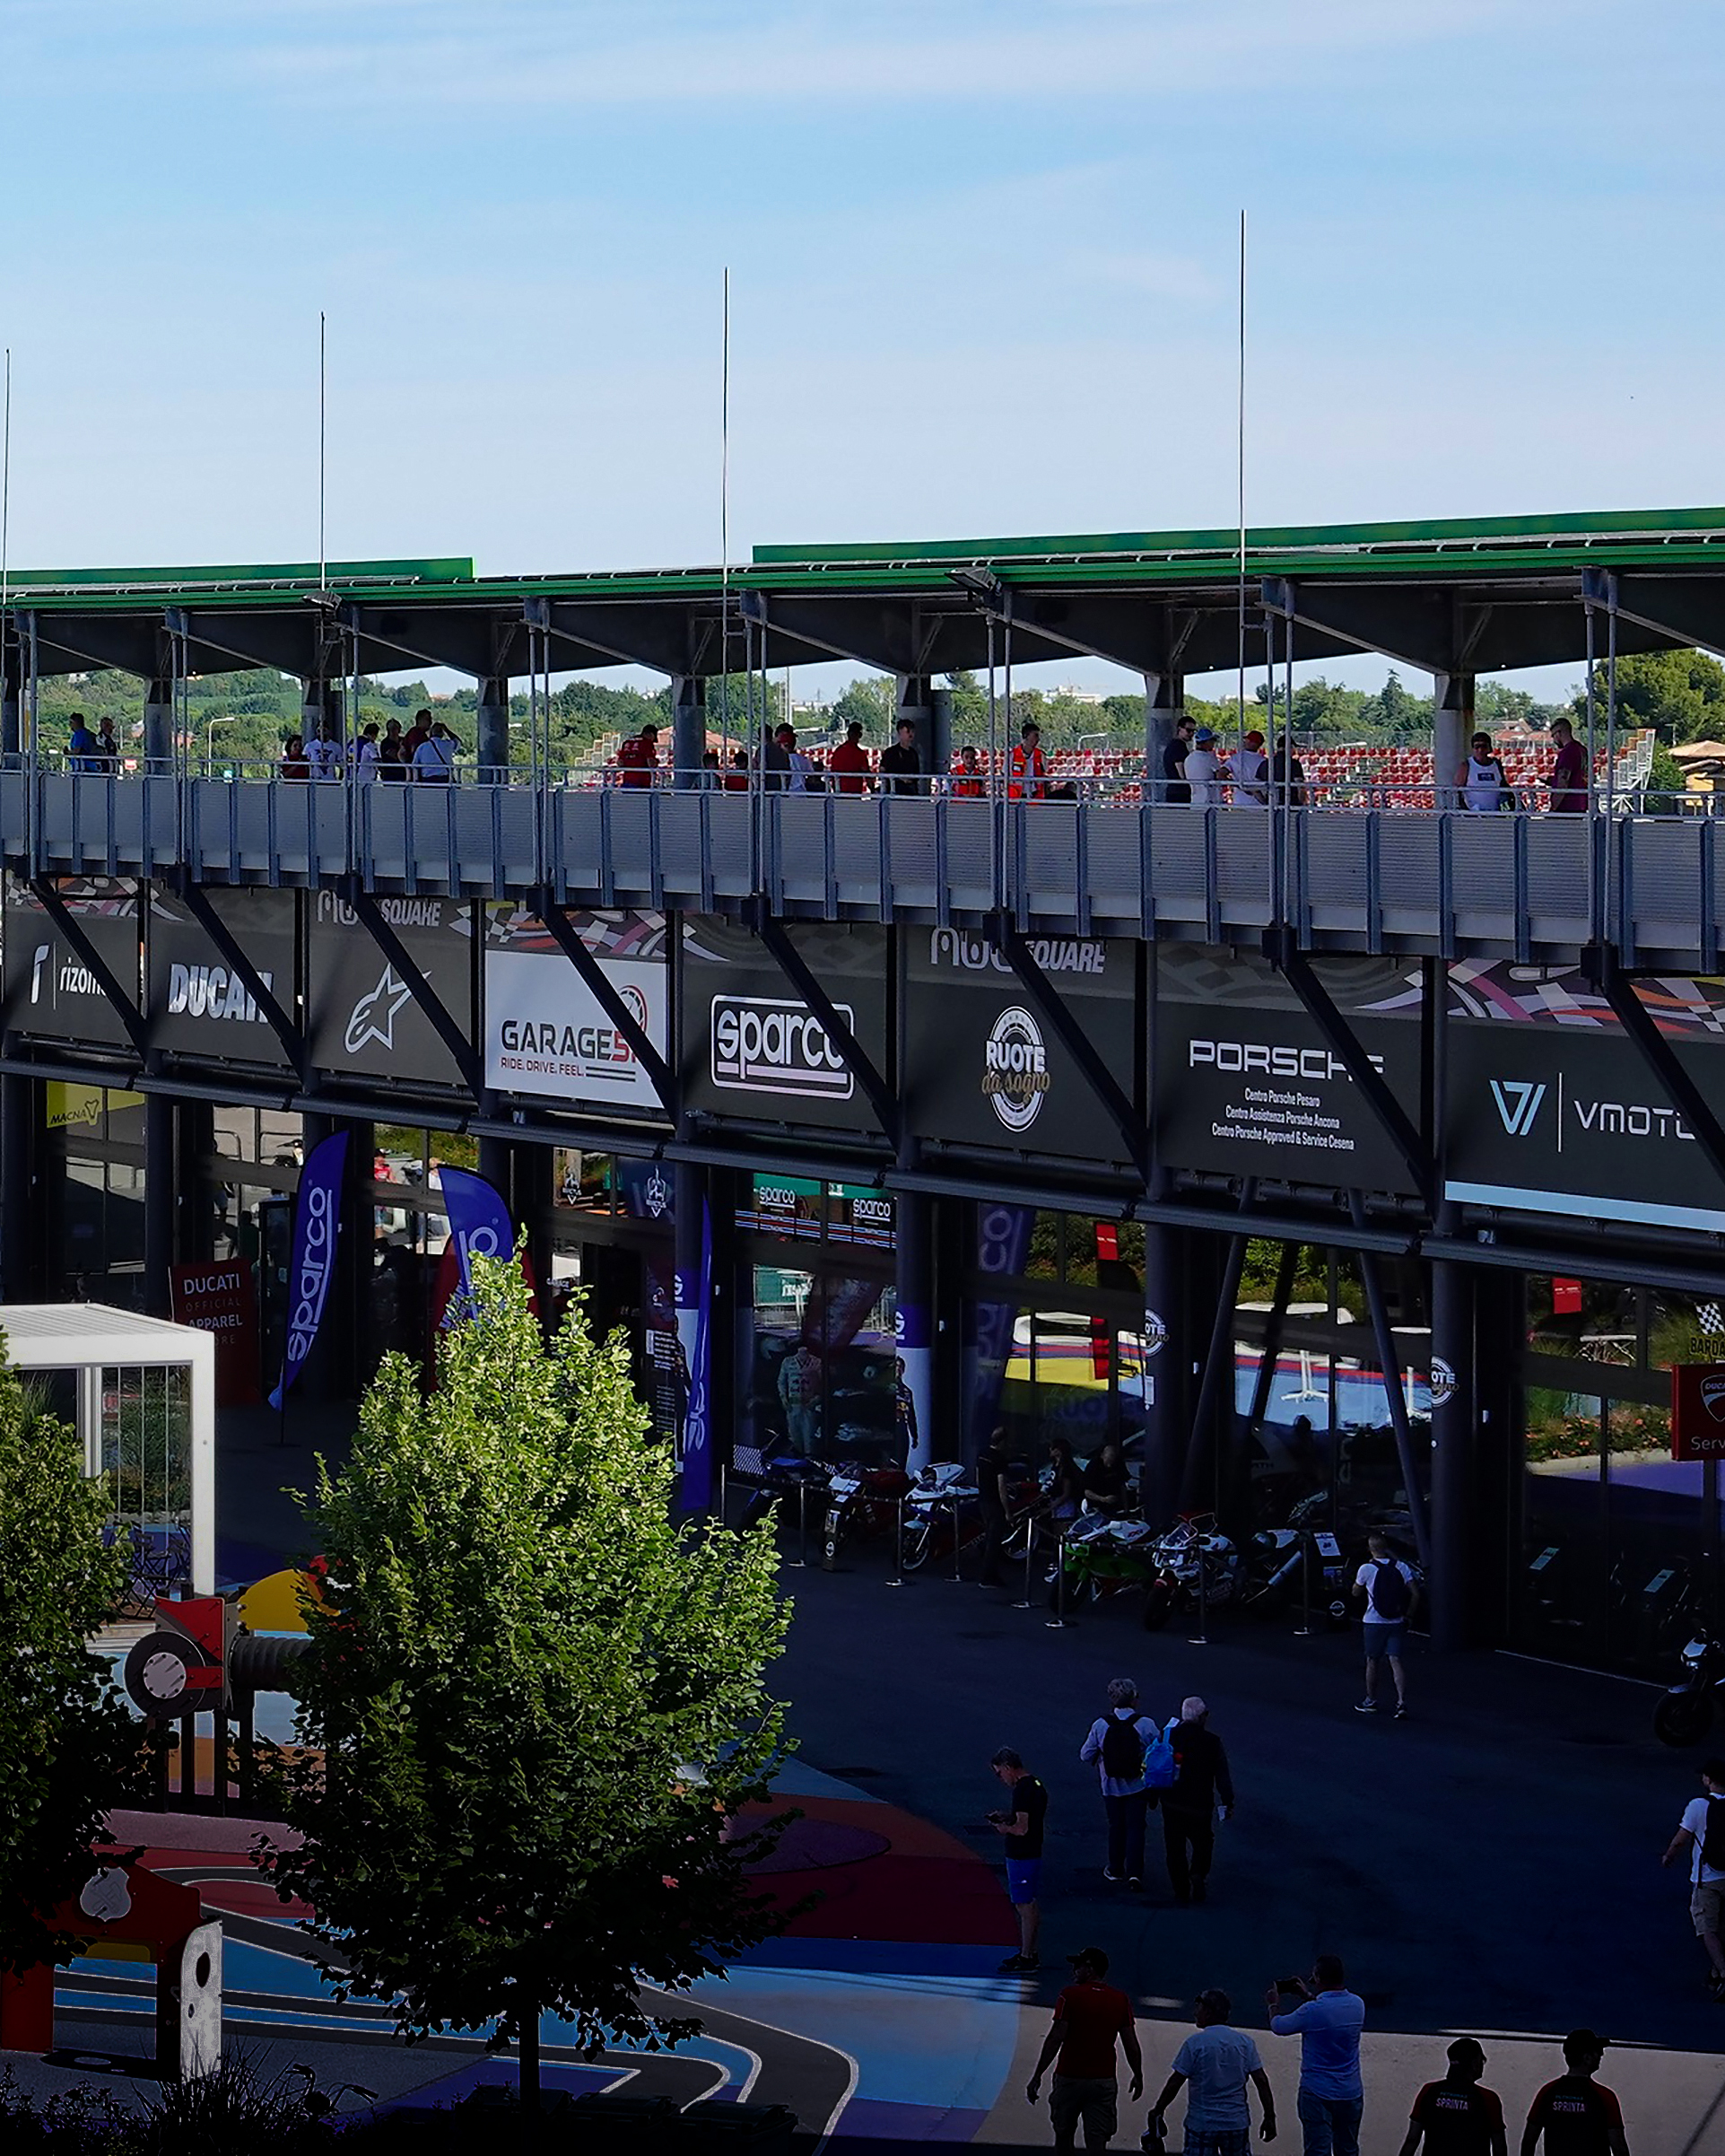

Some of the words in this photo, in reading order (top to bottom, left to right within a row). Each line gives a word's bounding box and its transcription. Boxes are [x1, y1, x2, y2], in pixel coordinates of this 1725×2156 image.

[501, 1020, 636, 1063] GARAGE5
[986, 1040, 1046, 1072] RUOTE
[501, 1057, 525, 1070] RIDE.
[526, 1060, 558, 1075] DRIVE.
[559, 1064, 585, 1077] FEEL.
[1004, 1071, 1051, 1105] sogno
[1244, 1087, 1268, 1103] Centro
[1268, 1089, 1296, 1105] Porsche
[1296, 1092, 1321, 1108] Pesaro
[1225, 1104, 1249, 1121] Centro
[1249, 1107, 1285, 1123] Assistenza
[1285, 1111, 1313, 1127] Porsche
[1313, 1113, 1341, 1130] Ancona
[1211, 1122, 1234, 1139] Centro
[1234, 1125, 1262, 1140] Porsche
[1262, 1128, 1295, 1146] Approved
[1295, 1130, 1302, 1144] &
[1302, 1133, 1329, 1148] Service
[1328, 1135, 1355, 1151] Cesena
[759, 1186, 796, 1206] sparco
[852, 1198, 892, 1219] sparco
[183, 1273, 240, 1295] DUCATI
[288, 1186, 327, 1362] sparco
[186, 1297, 241, 1313] OFFICIAL
[188, 1314, 243, 1329] APPAREL
[1145, 1322, 1167, 1335] OTE
[1431, 1371, 1455, 1384] OTE
